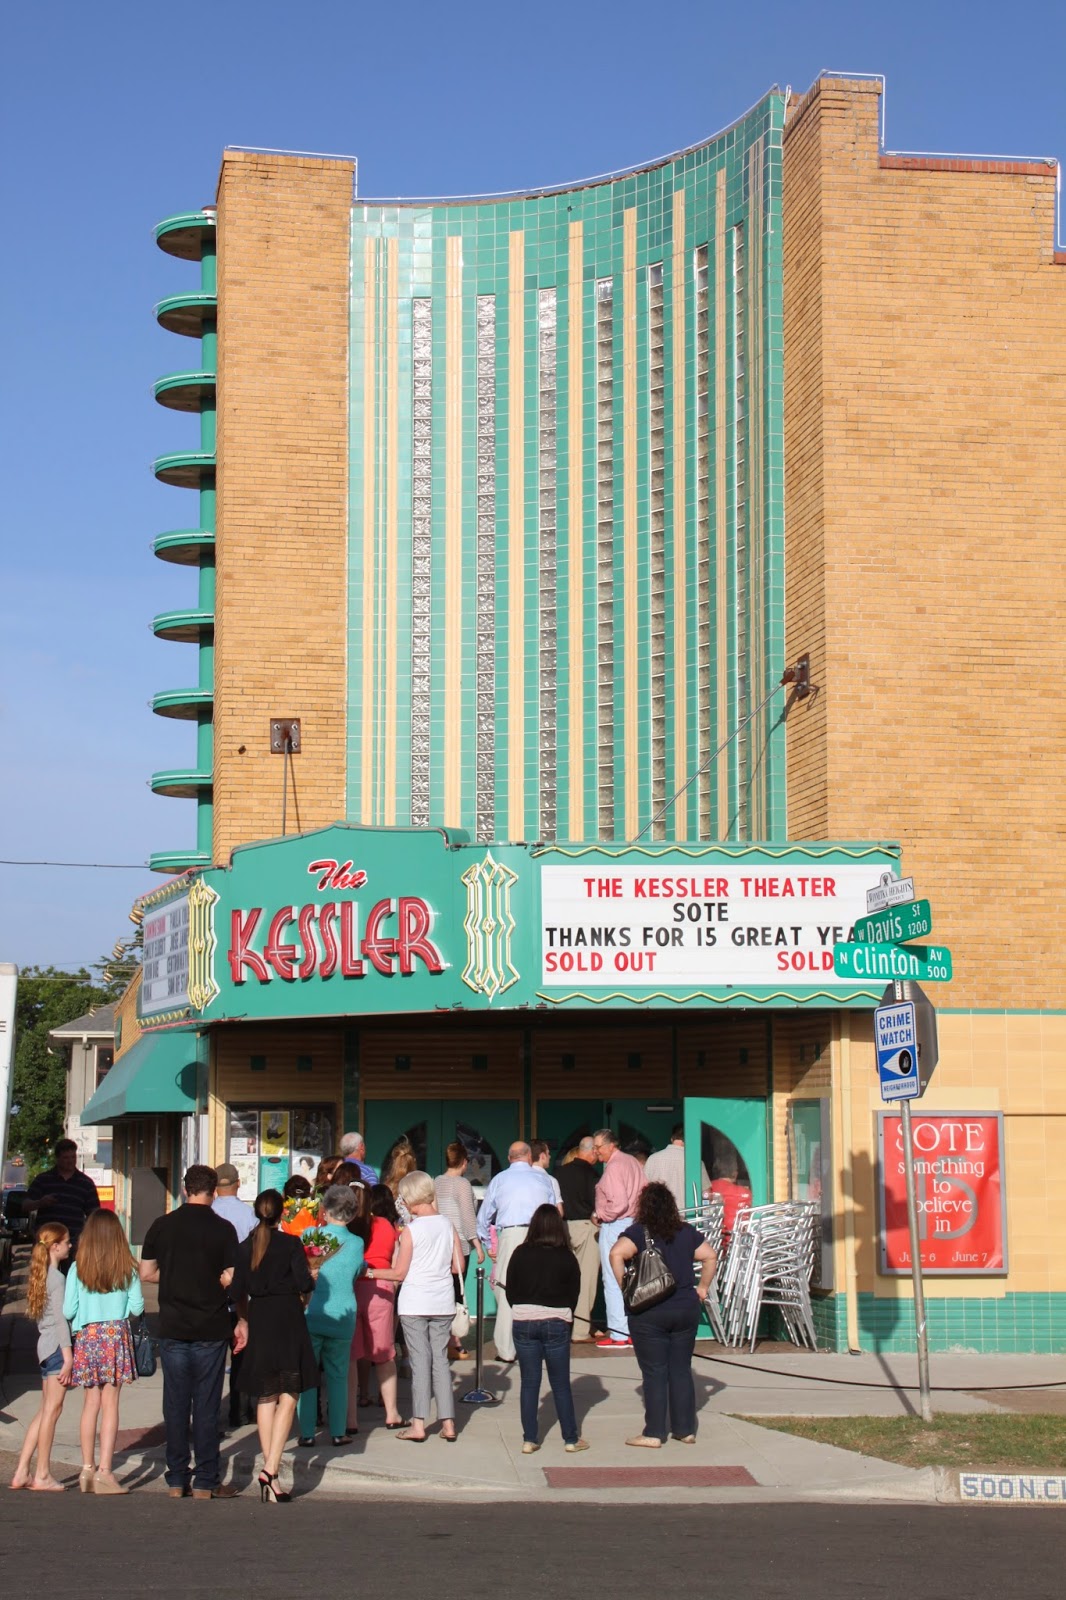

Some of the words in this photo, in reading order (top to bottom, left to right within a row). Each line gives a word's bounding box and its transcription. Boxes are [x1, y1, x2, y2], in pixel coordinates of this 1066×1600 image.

[307, 859, 369, 891] The
[583, 878, 623, 898] THE
[634, 878, 730, 898] KESSLER
[740, 878, 837, 897] THEATER
[673, 902, 729, 922] SOTE
[857, 929, 865, 941] W
[866, 911, 903, 944] Davis
[912, 903, 921, 917] St
[908, 919, 928, 936] 1200
[227, 896, 446, 983] KESSLER
[545, 927, 631, 947] THANKS
[643, 927, 684, 946] FOR
[697, 927, 717, 946] 15
[731, 926, 802, 946] GREAT
[545, 952, 603, 972] SOLD
[614, 952, 657, 971] OUT
[777, 951, 834, 971] SOLD
[840, 952, 848, 964] N
[853, 947, 919, 976] Clinton
[930, 949, 942, 961] Av
[927, 965, 947, 978] 500
[879, 1012, 911, 1030] CRIME
[880, 1028, 912, 1047] WATCH
[897, 1158, 985, 1178] smething
[933, 1179, 951, 1193] to
[935, 1216, 951, 1232] in
[899, 1252, 926, 1263] Jue
[929, 1253, 936, 1262] 6
[951, 1251, 979, 1262] June
[981, 1252, 988, 1262] 7
